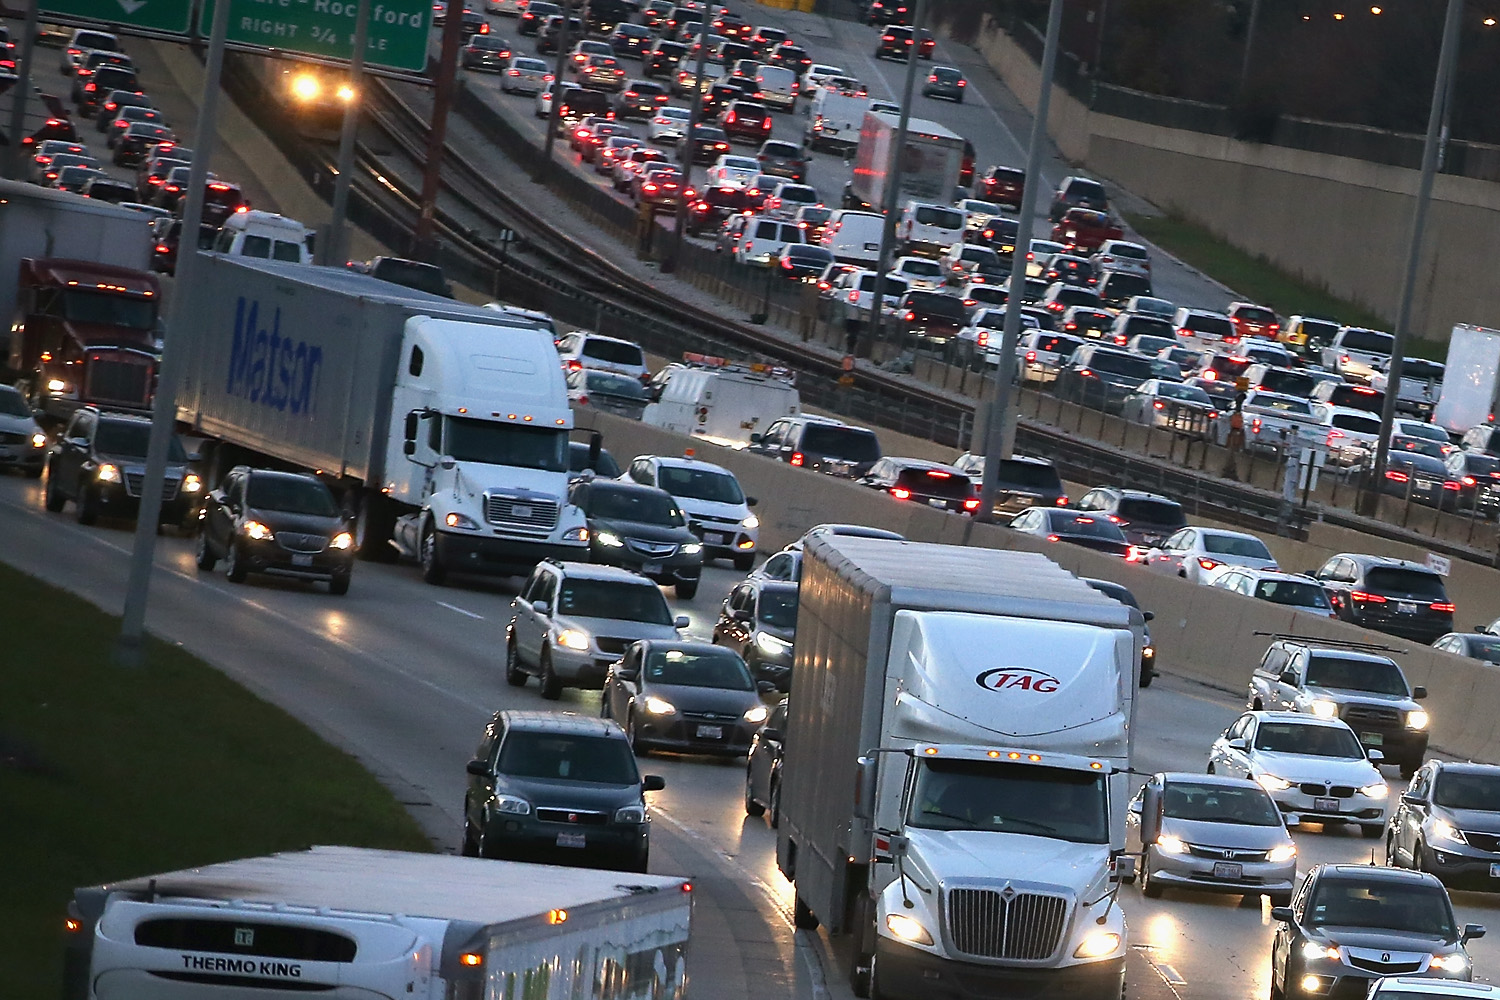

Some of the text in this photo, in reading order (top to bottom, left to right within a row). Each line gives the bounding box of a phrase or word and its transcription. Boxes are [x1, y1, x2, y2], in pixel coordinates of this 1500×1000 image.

[314, 0, 423, 28] Rocford
[241, 17, 299, 38] RIGHT
[311, 26, 337, 44] 3/4
[227, 296, 323, 415] Matson
[994, 673, 1060, 692] TAG
[182, 955, 302, 977] THERMO KING
